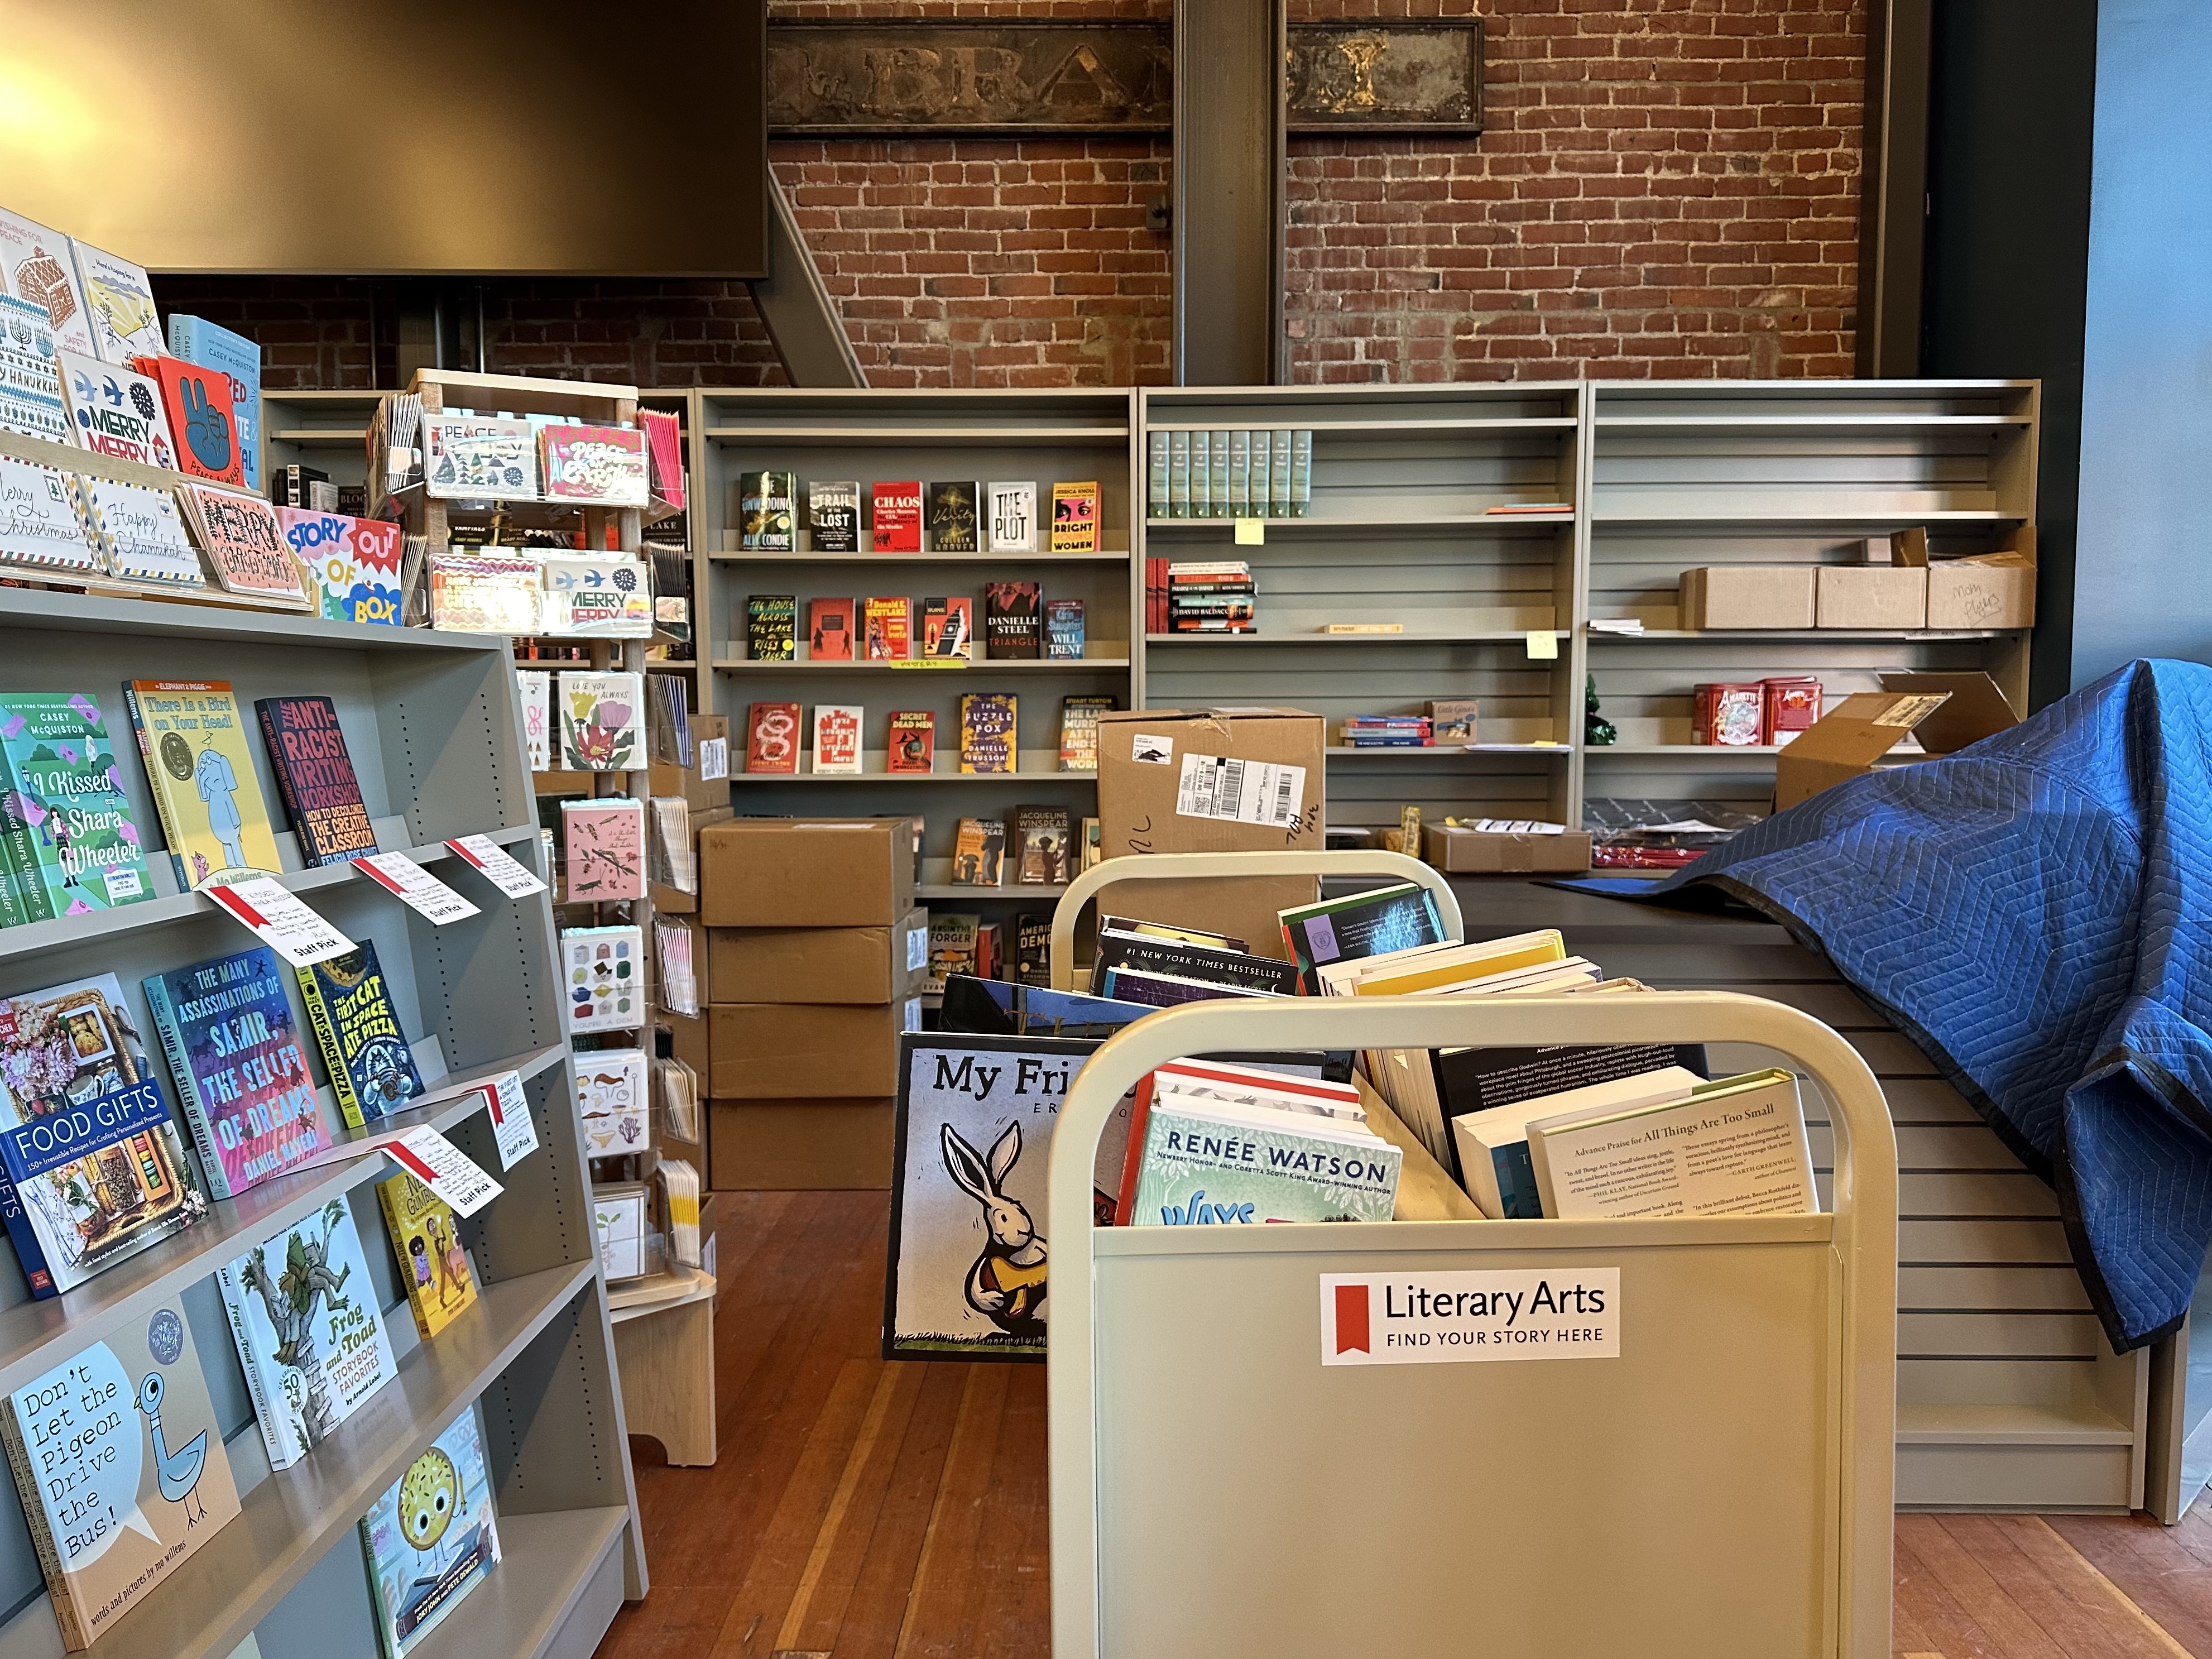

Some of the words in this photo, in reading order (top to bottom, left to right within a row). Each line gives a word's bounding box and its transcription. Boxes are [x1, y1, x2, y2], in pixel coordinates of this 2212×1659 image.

[28, 233, 42, 244] FOR
[209, 348, 227, 362] CASEY
[10, 369, 59, 396] HANUKKAH
[89, 405, 150, 444] MERRY
[87, 431, 147, 464] MERRY
[819, 494, 850, 507] TRAIL
[874, 496, 920, 508] CHAOS
[996, 492, 1020, 517] THE
[108, 502, 157, 540] Happy
[650, 521, 677, 530] LAKE
[820, 514, 850, 527] LOST
[933, 507, 976, 526] Verity
[287, 517, 348, 553] STORY
[358, 526, 397, 558] OUT
[995, 517, 1026, 540] PLOT
[1054, 523, 1093, 533] BRIGHT
[1054, 532, 1092, 541] YOUNG
[762, 534, 789, 546] CONDIE
[1054, 541, 1092, 550] WOMEN
[327, 559, 356, 586] OF
[354, 596, 397, 625] BOX
[749, 601, 764, 611] THE
[769, 600, 794, 611] HOUSE
[874, 600, 899, 608] Donald
[757, 613, 789, 621] ACROSS
[988, 617, 1038, 625] DANIELLE
[750, 624, 766, 634] THE
[768, 623, 793, 633] LAKE
[989, 638, 1038, 646] TRIANGLE
[1052, 634, 1077, 644] WILL
[760, 650, 787, 660] SAGER
[1049, 645, 1081, 655] TRENT
[160, 682, 185, 691] ELEPHANT
[572, 682, 589, 690] LOVE
[592, 682, 606, 691] YOU
[601, 691, 629, 699] ALWAYS
[126, 689, 139, 720] Willems
[145, 697, 181, 712] There
[181, 698, 195, 712] Is
[198, 703, 205, 711] a
[206, 697, 232, 712] Bird
[1065, 709, 1083, 718] THE
[40, 713, 69, 722] CASEY
[154, 718, 169, 731] on
[169, 715, 198, 730] Your
[200, 714, 233, 728] Head!
[965, 712, 1012, 721] PUZZLE
[976, 725, 1001, 733] BOX
[281, 729, 346, 761] RACIST
[1076, 750, 1095, 758] THE
[289, 758, 355, 788] WRITING
[48, 769, 111, 803] Kissed
[298, 784, 361, 810] WORKSHOP
[68, 808, 124, 838] Shara
[305, 811, 320, 821] HOW
[320, 809, 331, 819] TO
[962, 821, 1005, 829] JACQUELINE
[308, 821, 332, 838] THE
[333, 814, 370, 834] CREATIVE
[961, 827, 1004, 836] WINSPEAR
[315, 829, 375, 855] CLASSROOM
[58, 840, 141, 875] Wheeler
[320, 855, 346, 866] FELICIA
[347, 851, 361, 861] ROSE
[429, 907, 447, 918] Staff
[446, 903, 463, 913] Pick
[293, 943, 318, 957] Staff
[318, 938, 339, 951] Pick
[930, 933, 971, 943] FORGER
[195, 970, 218, 990] THE
[219, 958, 250, 985] MANY
[1140, 950, 1163, 960] NEW
[1165, 953, 1192, 964] YORK
[1196, 958, 1225, 969] TIMES
[1228, 963, 1282, 979] BESTSELLER
[178, 984, 265, 1024] ASSASSINATIONS
[266, 977, 280, 996] OF
[333, 995, 346, 1007] THE
[336, 995, 357, 1021] FIRST
[356, 975, 381, 1005] CAT
[340, 1020, 352, 1033] IN
[353, 998, 388, 1028] SPACE
[209, 1011, 279, 1058] SAMIR,
[343, 1029, 362, 1059] ATE
[361, 1017, 398, 1041] PIZZA
[202, 1071, 243, 1108] THE
[243, 1044, 304, 1092] SELLER
[932, 1053, 1002, 1101] My
[1496, 1067, 1518, 1076] describe
[1519, 1061, 1541, 1071] Godwin?
[15, 1112, 91, 1159] FOOD
[96, 1085, 157, 1126] GIFTS
[249, 1084, 315, 1141] DREAMS
[1575, 1143, 1606, 1157] Advance
[1607, 1139, 1630, 1150] Praise
[1631, 1135, 1642, 1145] for
[1643, 1130, 1659, 1143] All
[1661, 1123, 1698, 1138] Things
[1700, 1119, 1720, 1130] Are
[1721, 1113, 1743, 1125] Too
[1744, 1102, 1774, 1120] Small
[1717, 1135, 1736, 1144] spring
[1736, 1131, 1750, 1140] from
[28, 1160, 42, 1171] 150+
[42, 1150, 70, 1165] Irresistible
[69, 1144, 89, 1155] Recipes
[96, 1131, 118, 1143] Crafting
[144, 1112, 162, 1123] Presents
[519, 1136, 531, 1147] Pick
[1167, 1130, 1256, 1162] RENÉE
[1268, 1147, 1386, 1183] WATSON
[474, 1182, 492, 1195] Pick
[220, 1267, 231, 1287] Lobel
[1385, 1284, 1524, 1327] Literary
[1529, 1281, 1605, 1315] Arts
[328, 1303, 363, 1346] Frog
[326, 1349, 343, 1371] and
[342, 1315, 377, 1355] Toad
[1387, 1333, 1431, 1347] FIND
[1437, 1331, 1487, 1346] YOUR
[1493, 1330, 1551, 1344] STORY
[1557, 1328, 1604, 1342] HERE
[332, 1341, 379, 1384] STORYBOOK
[339, 1355, 380, 1395] FAVORITES
[23, 1364, 92, 1418] Don't
[284, 1373, 299, 1399] 50
[345, 1395, 353, 1406] by
[31, 1409, 75, 1447] Let
[81, 1382, 118, 1413] the
[40, 1412, 121, 1474] Pigeon
[47, 1444, 117, 1502] Drive
[58, 1491, 100, 1527] the
[64, 1505, 118, 1559] Bus!
